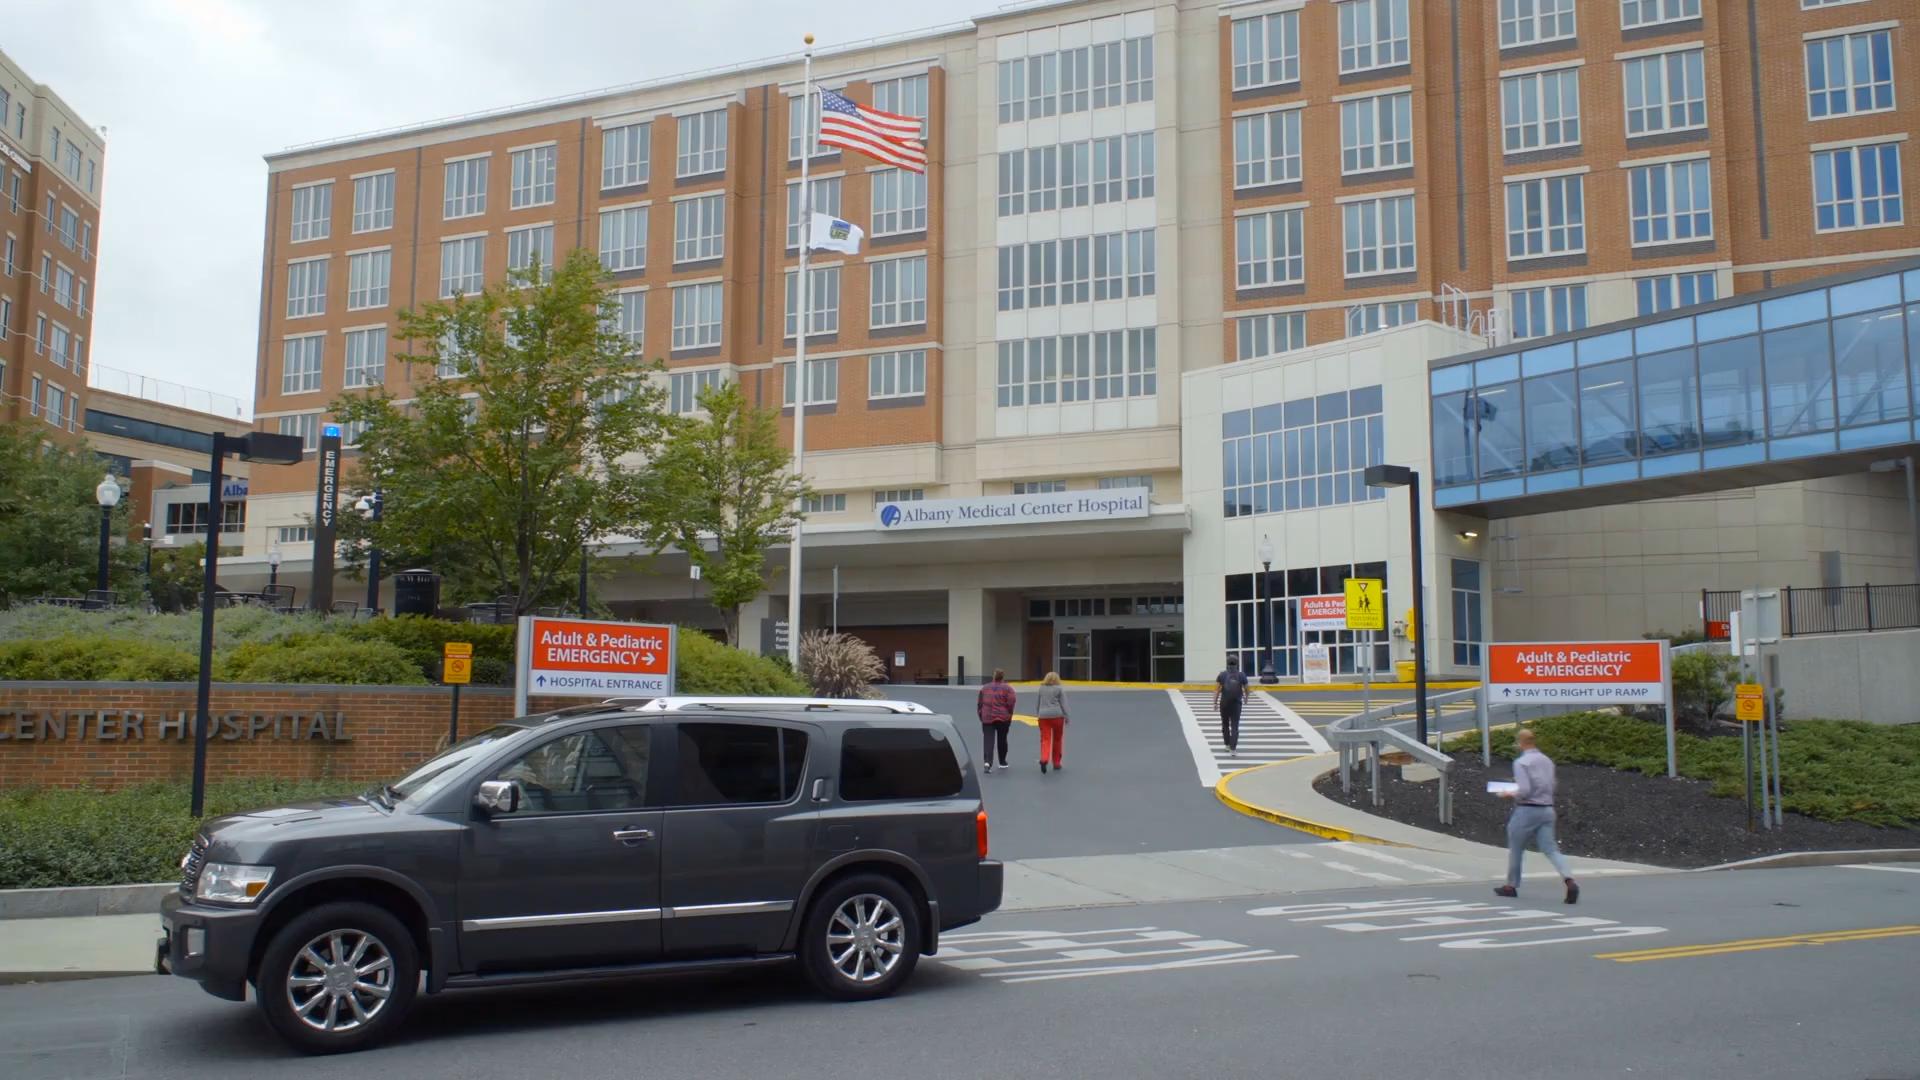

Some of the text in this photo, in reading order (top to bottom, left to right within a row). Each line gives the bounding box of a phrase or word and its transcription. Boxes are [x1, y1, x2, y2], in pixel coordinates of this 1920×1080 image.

[322, 451, 335, 527] EMERGENCY
[903, 495, 1143, 524] Albany Medical Center Hospital
[1304, 601, 1324, 609] Adult
[541, 630, 663, 650] Adult & Pediatric
[547, 647, 640, 665] EMERGENCY
[1516, 650, 1631, 664] Adult & Pediatric
[1536, 664, 1622, 677] EMERGENCY
[550, 676, 663, 690] HOSPITAL ENTRANCE
[1515, 688, 1648, 698] STAY TO RIGHT UP RAMP
[158, 711, 353, 741] HOSPITAL
